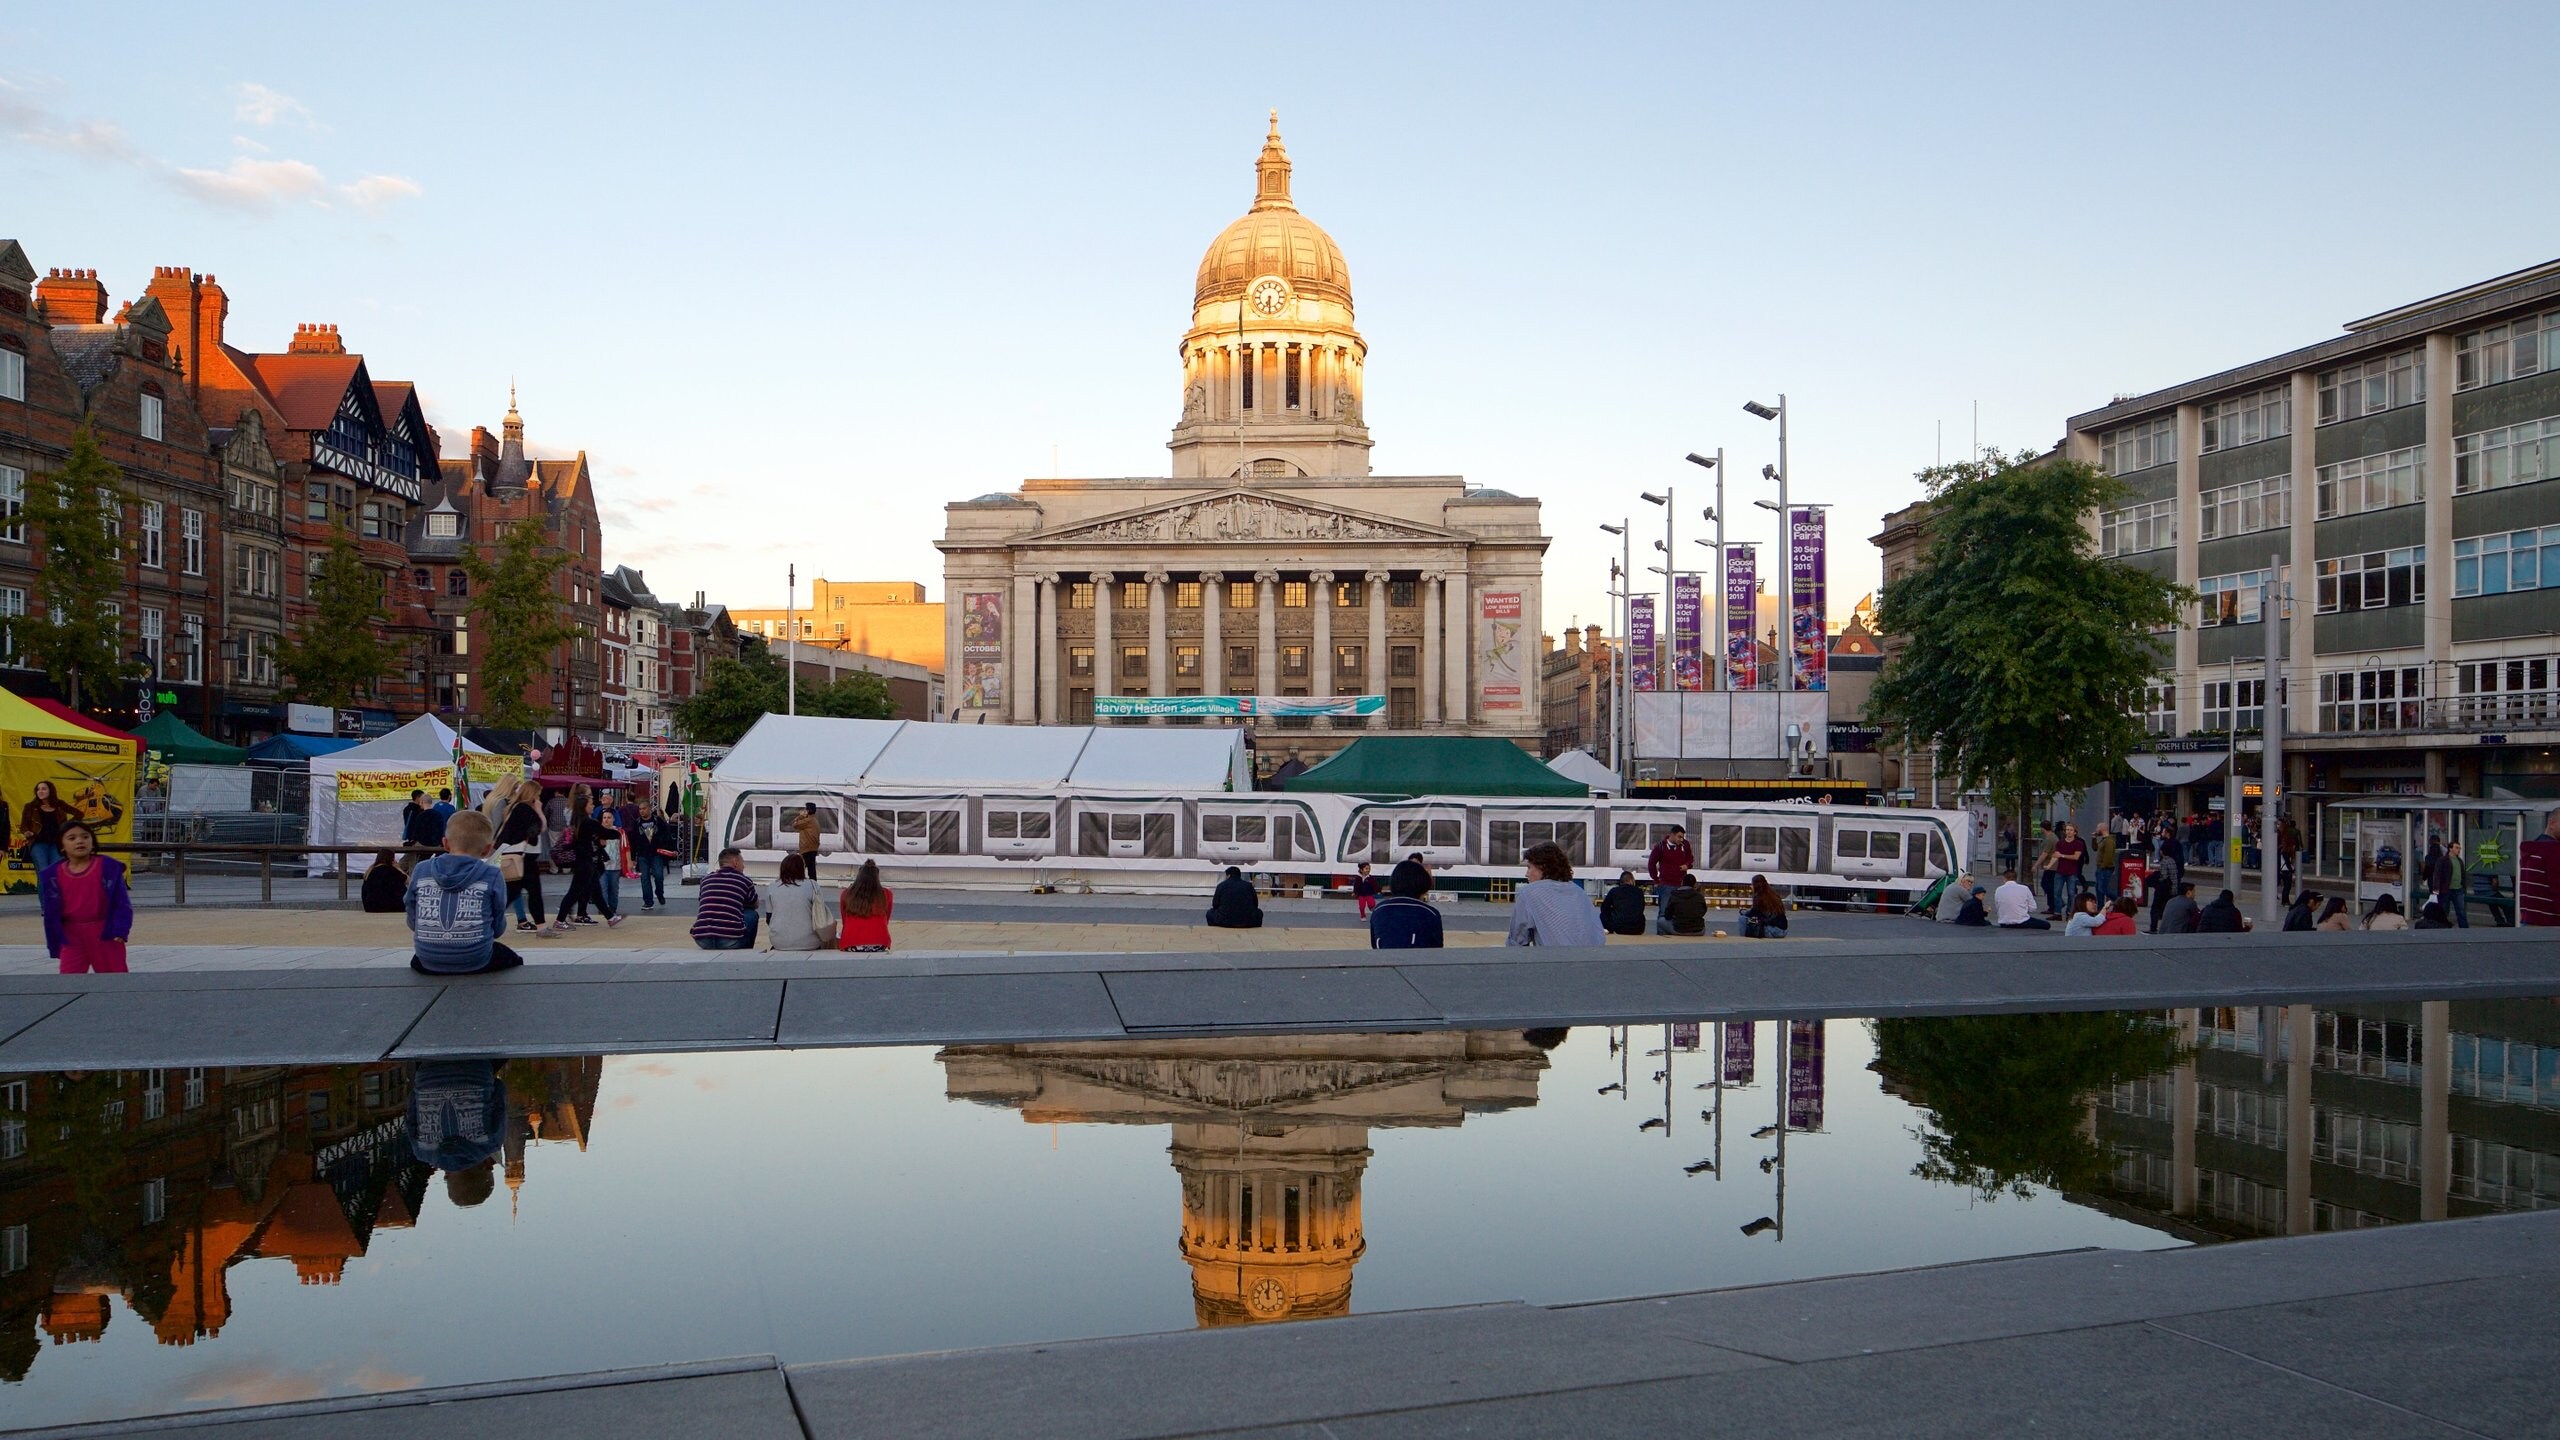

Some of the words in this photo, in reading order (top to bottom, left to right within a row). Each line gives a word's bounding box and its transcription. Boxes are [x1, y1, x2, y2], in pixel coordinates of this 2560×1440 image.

[1793, 523, 1824, 532] Goose
[1793, 531, 1811, 540] Fair
[1804, 546, 1820, 554] Sep
[1728, 566, 1744, 574] Fair
[1793, 563, 1812, 571] 2015
[1737, 578, 1751, 586] Sep
[1485, 596, 1520, 604] WANTED
[1095, 703, 1133, 715] Harvey
[1135, 703, 1177, 713] Hadden
[1181, 705, 1207, 714] Sports
[1208, 705, 1235, 714] Village
[24, 739, 37, 747] VISIT
[38, 740, 118, 752] WWW.AMBUCOPTER.ORG.UK
[2155, 742, 2180, 751] JOSEPH
[2182, 742, 2198, 750] ELSE
[465, 753, 503, 764] NOTTINGHAM
[504, 757, 522, 765] CARS
[339, 772, 412, 782] NOTTINGHAM
[415, 770, 449, 780] CARS
[339, 781, 374, 789] 0115
[392, 780, 418, 789] 700
[424, 778, 448, 787] 700
[418, 887, 441, 897] SURF
[417, 896, 440, 906] EST
[460, 898, 483, 909] HIGH
[418, 907, 439, 918] 1926
[457, 909, 482, 918] TIDE
